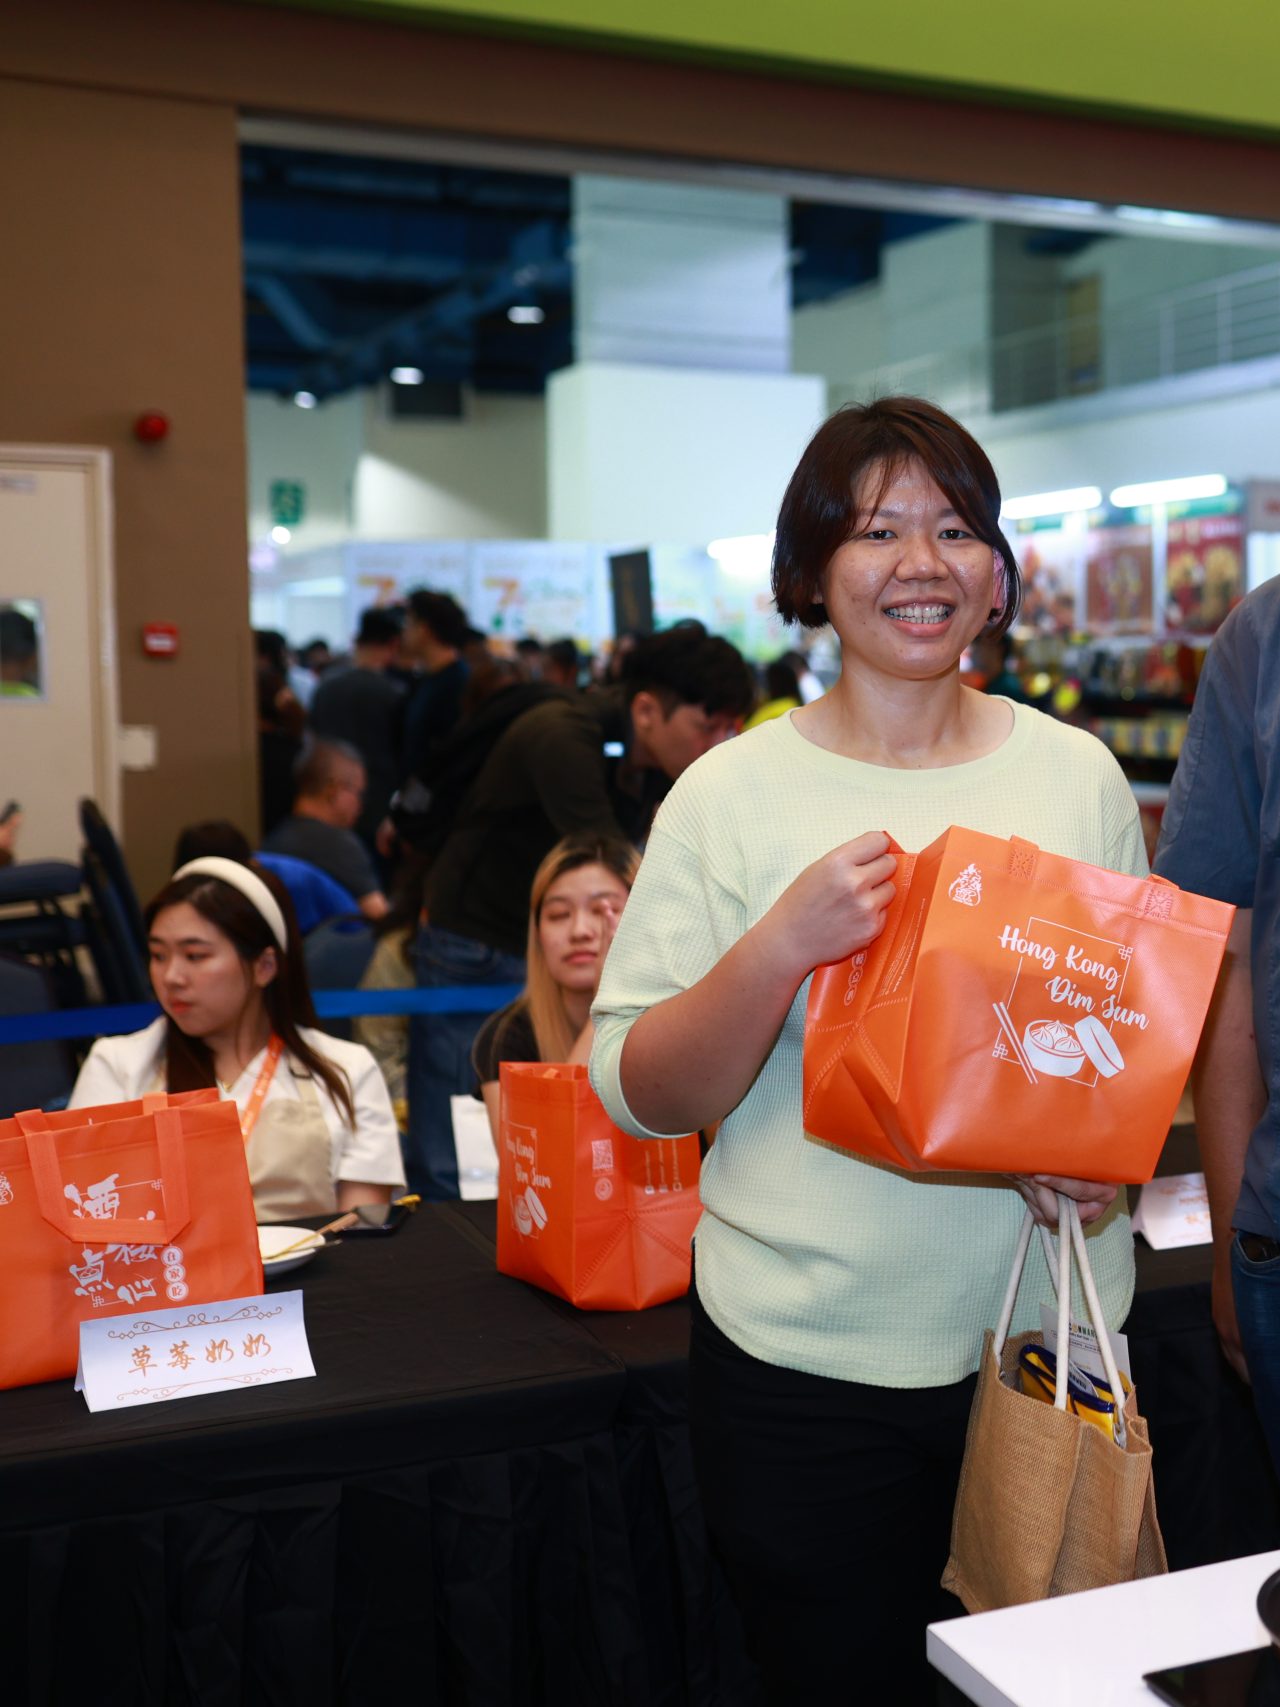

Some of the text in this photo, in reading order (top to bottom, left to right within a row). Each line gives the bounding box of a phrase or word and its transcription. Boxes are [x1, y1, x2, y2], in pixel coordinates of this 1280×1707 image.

[998, 924, 1122, 991] Hong Kong
[1045, 975, 1150, 1031] Dim Sum
[128, 1332, 272, 1377] 草莓奶奶
